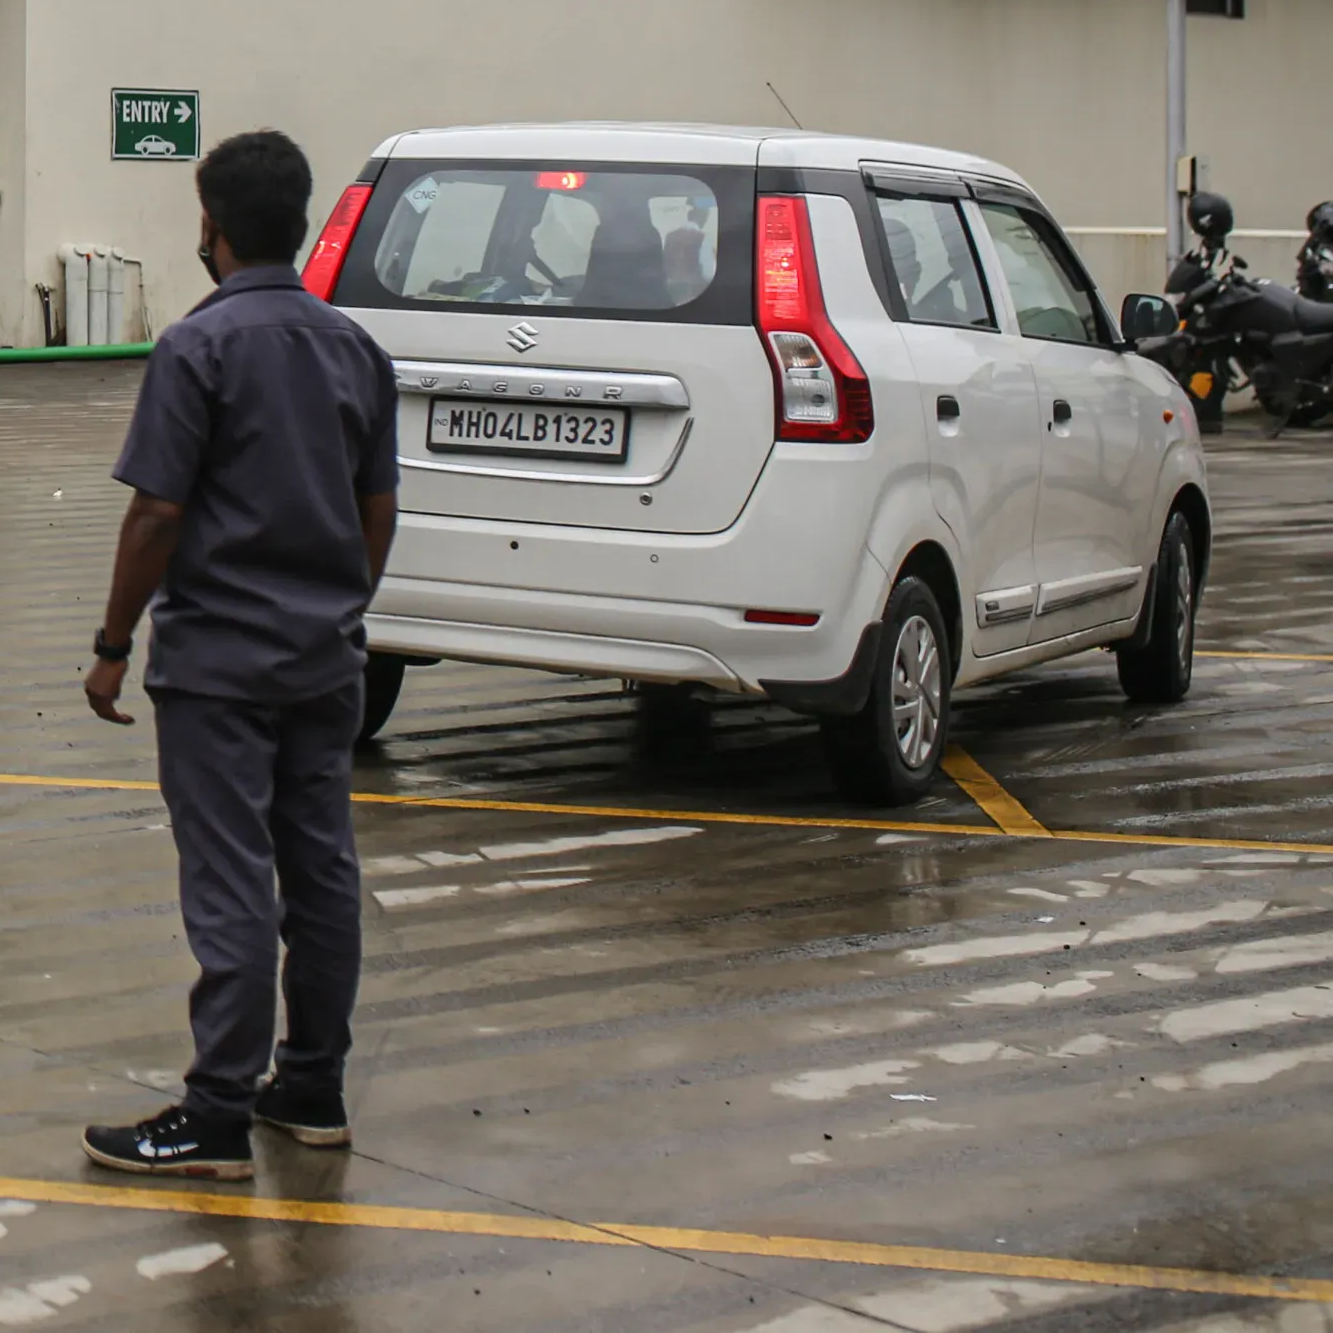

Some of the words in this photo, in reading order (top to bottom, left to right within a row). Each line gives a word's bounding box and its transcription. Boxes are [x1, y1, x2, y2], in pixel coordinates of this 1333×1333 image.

[122, 99, 171, 123] ENTRY
[413, 190, 437, 200] CNG
[449, 409, 615, 446] MH04LB1323
